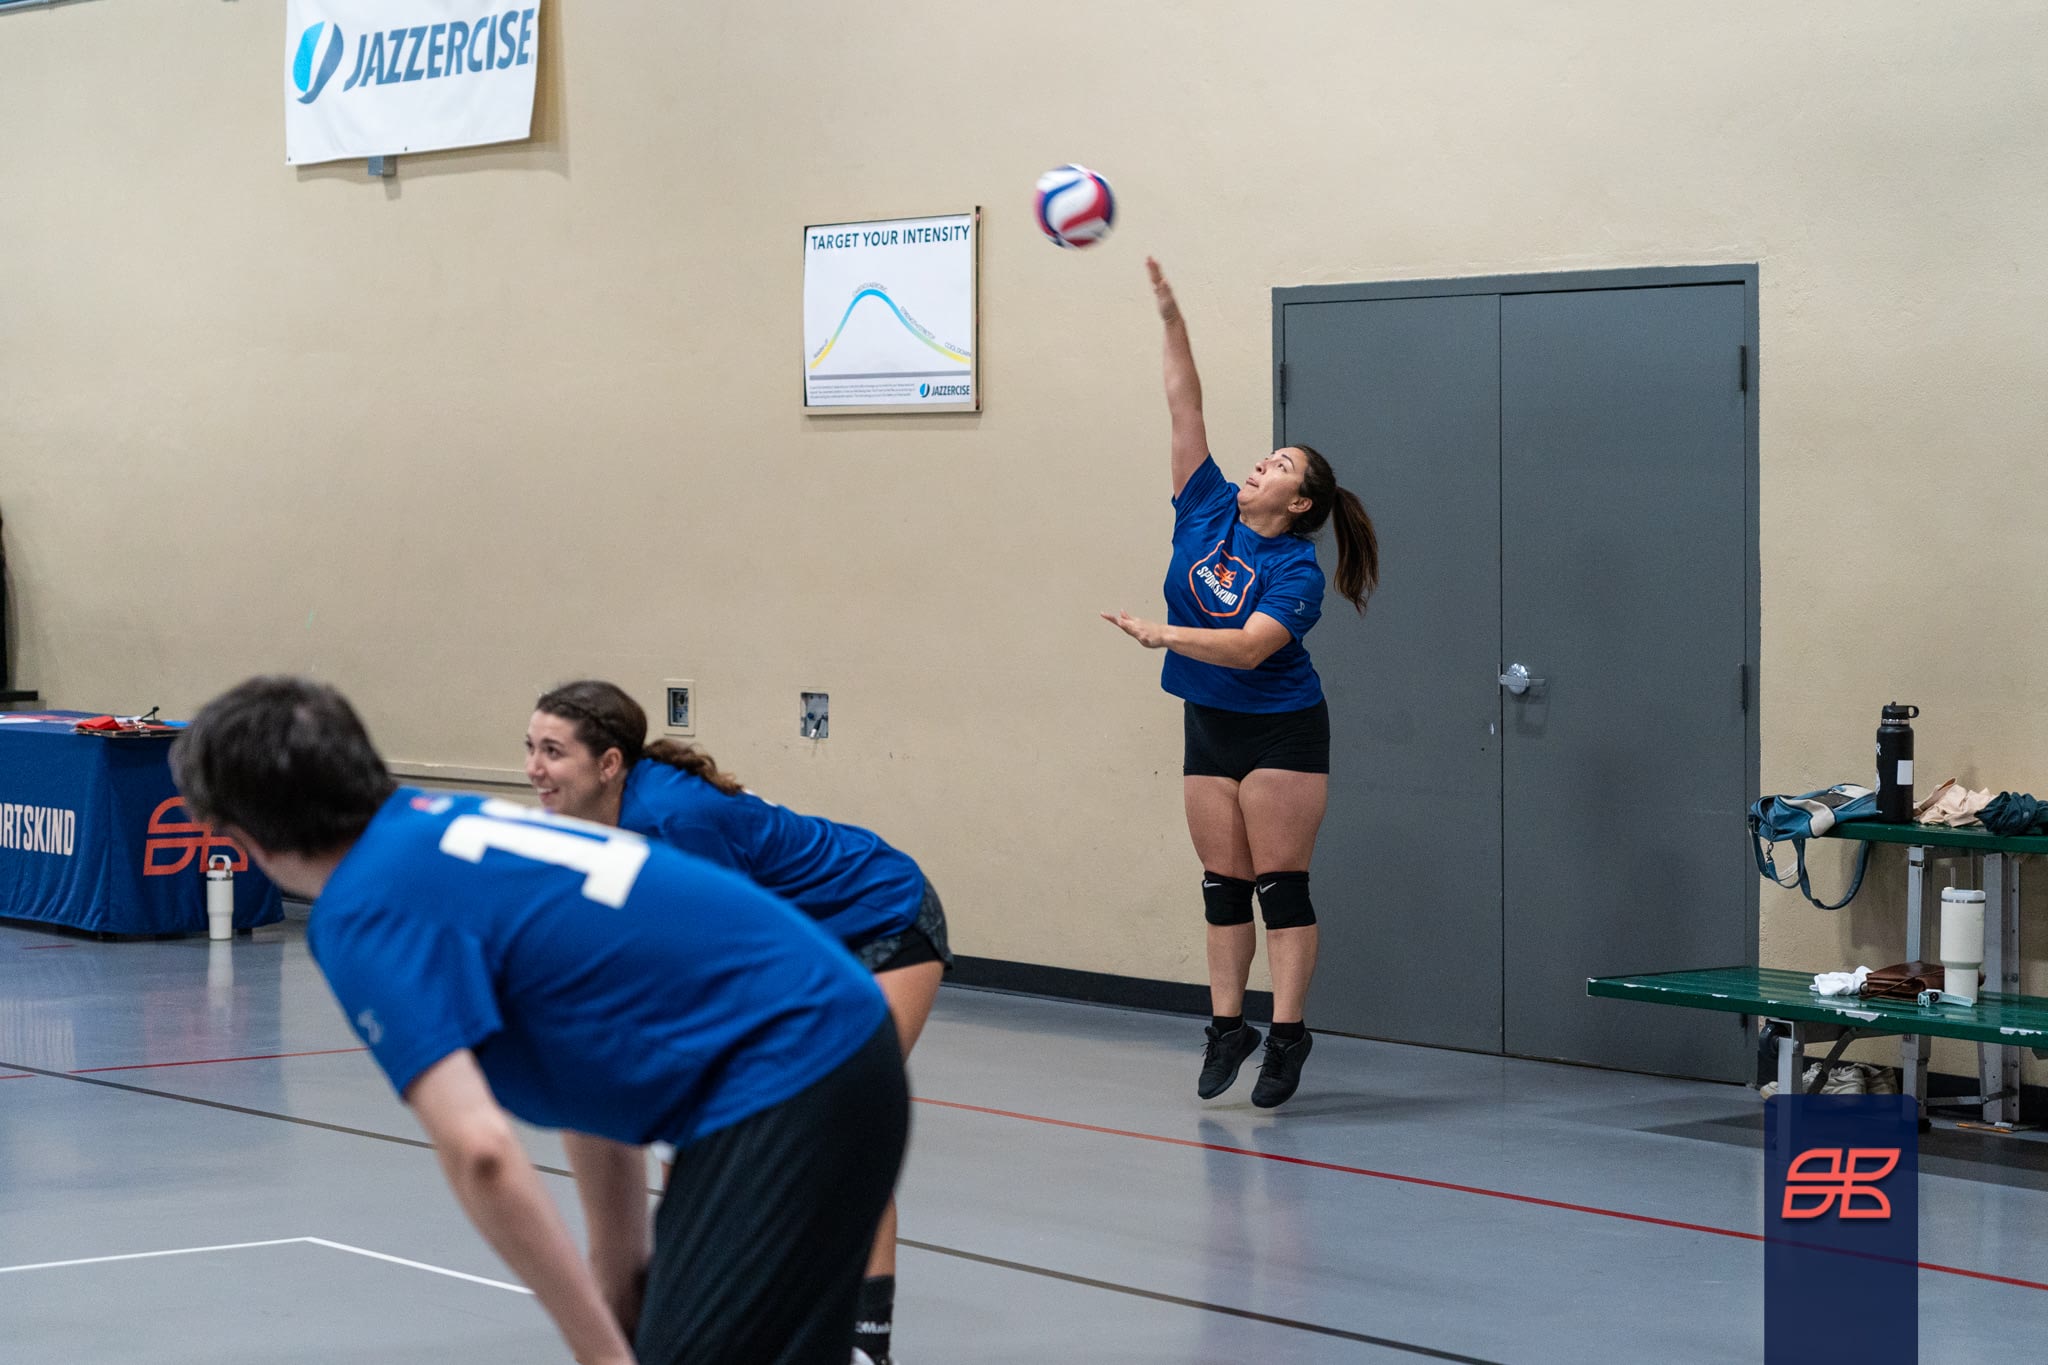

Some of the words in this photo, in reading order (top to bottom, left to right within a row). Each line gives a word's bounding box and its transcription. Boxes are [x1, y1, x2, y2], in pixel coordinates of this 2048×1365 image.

[342, 8, 535, 92] JAZZERCISE
[812, 233, 859, 250] TARGET
[863, 230, 898, 247] YOUR
[903, 225, 970, 244] INTENSITY
[931, 384, 970, 396] JAZZERCISE
[0, 802, 75, 856] RTSKIND
